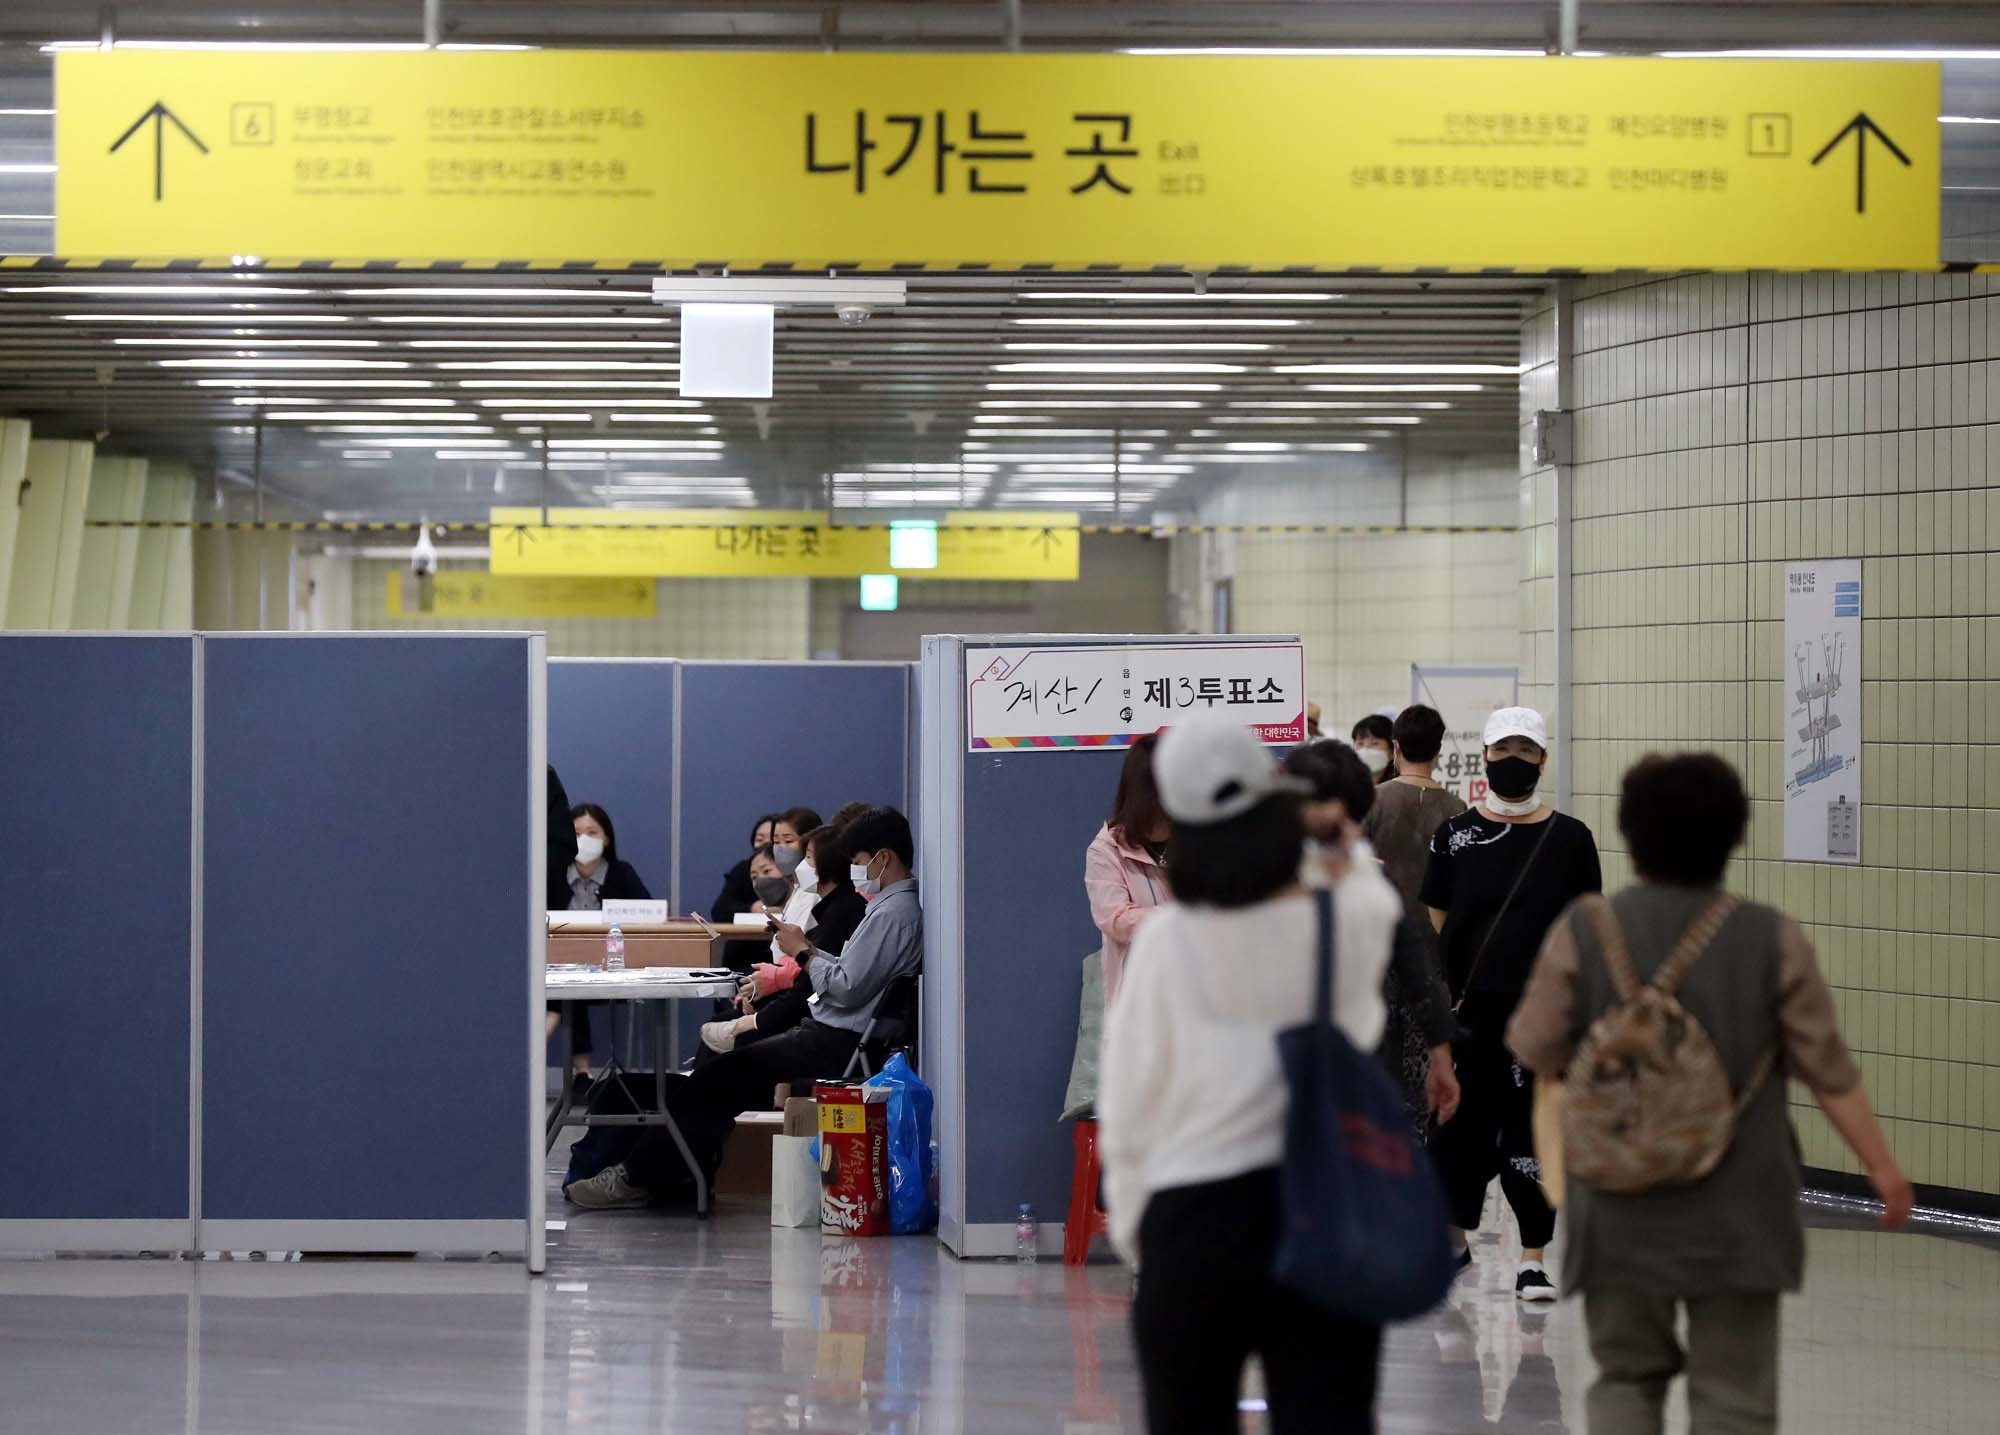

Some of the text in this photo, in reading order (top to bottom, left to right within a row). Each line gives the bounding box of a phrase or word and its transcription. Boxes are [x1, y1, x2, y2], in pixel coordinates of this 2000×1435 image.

[244, 113, 262, 139] 6
[1762, 121, 1776, 148] 1
[804, 109, 1140, 196] 나가는 곳
[1158, 140, 1200, 161] Exit
[1143, 676, 1286, 710] 제3투표소
[1264, 727, 1301, 739] 대한민국
